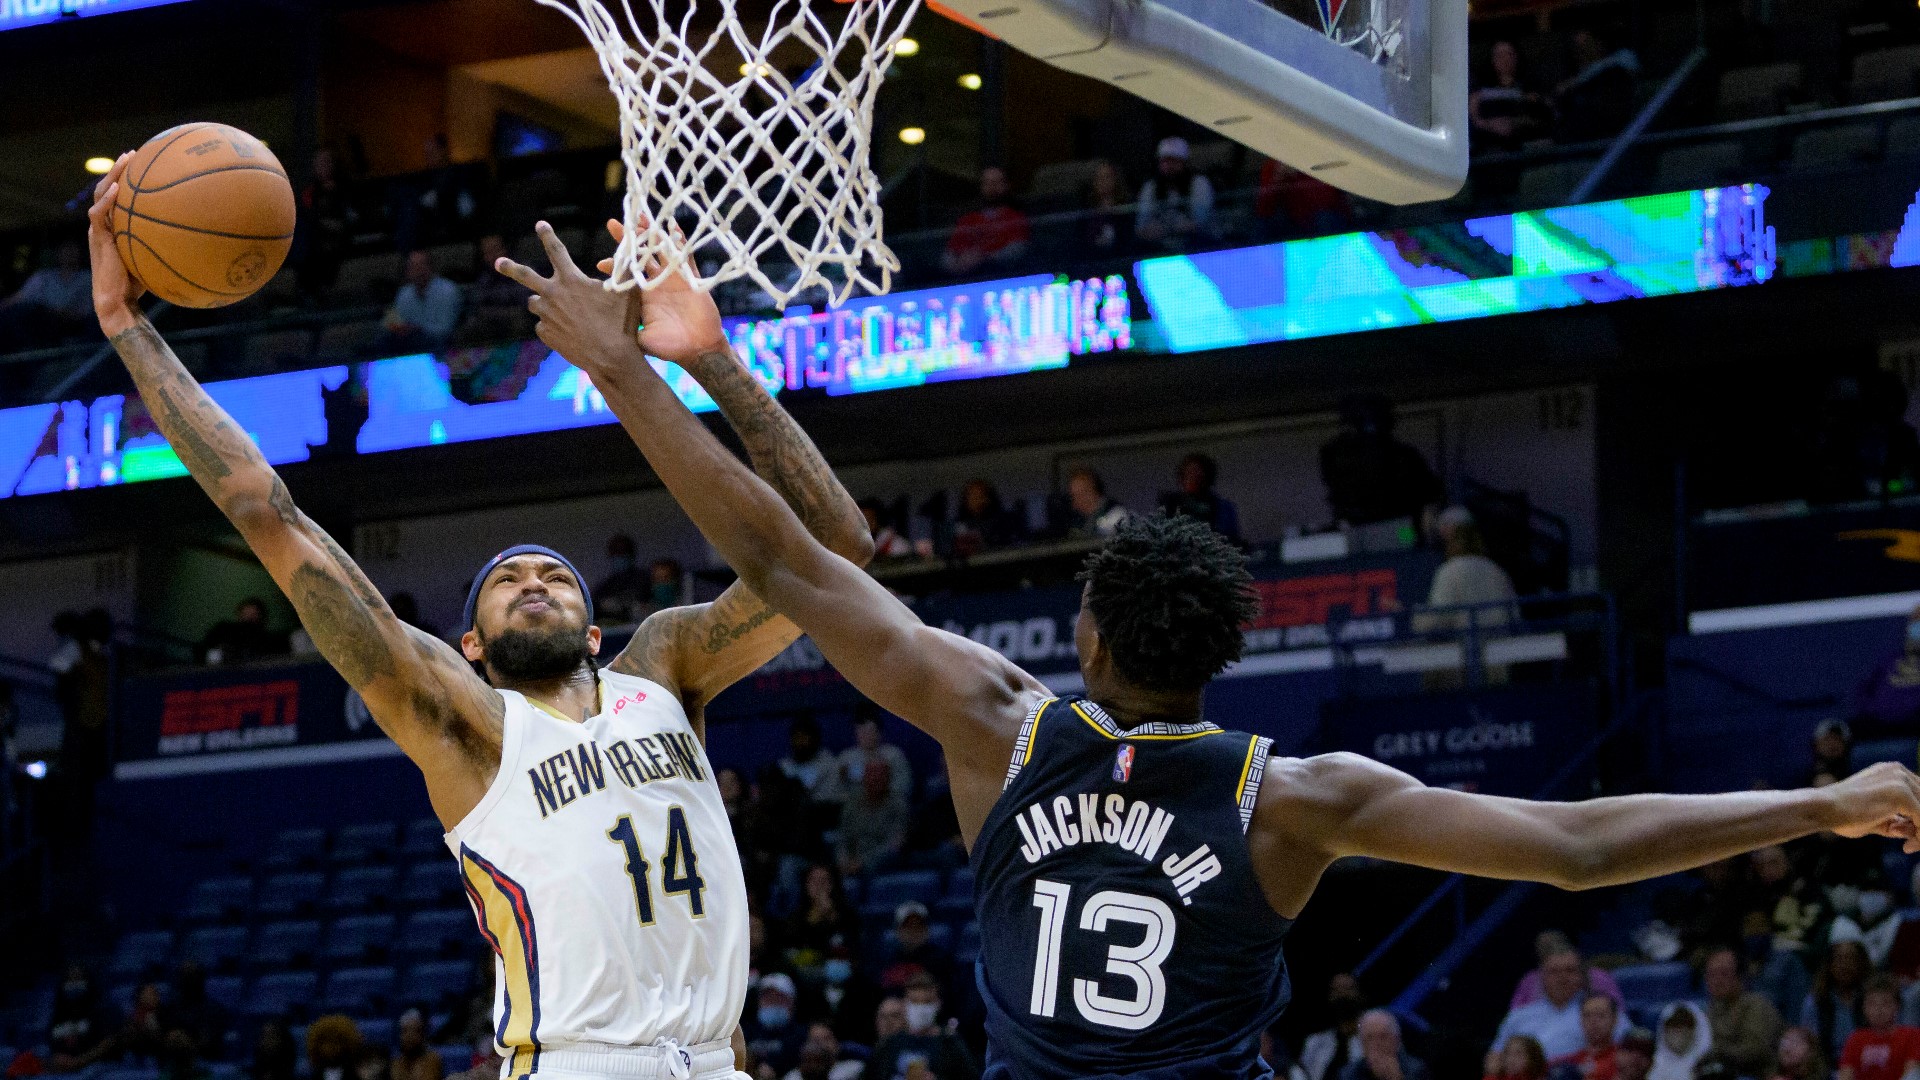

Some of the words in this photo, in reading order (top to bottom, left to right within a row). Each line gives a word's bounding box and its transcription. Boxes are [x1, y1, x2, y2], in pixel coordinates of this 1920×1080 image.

[160, 679, 299, 737] ESPN
[1373, 730, 1442, 760] GREY
[1444, 720, 1536, 754] GOOSE
[528, 740, 606, 819] NEW
[606, 804, 707, 928] 14
[1015, 793, 1176, 864] JACKSON
[1162, 843, 1223, 907] JR.
[1030, 878, 1177, 1030] 13
